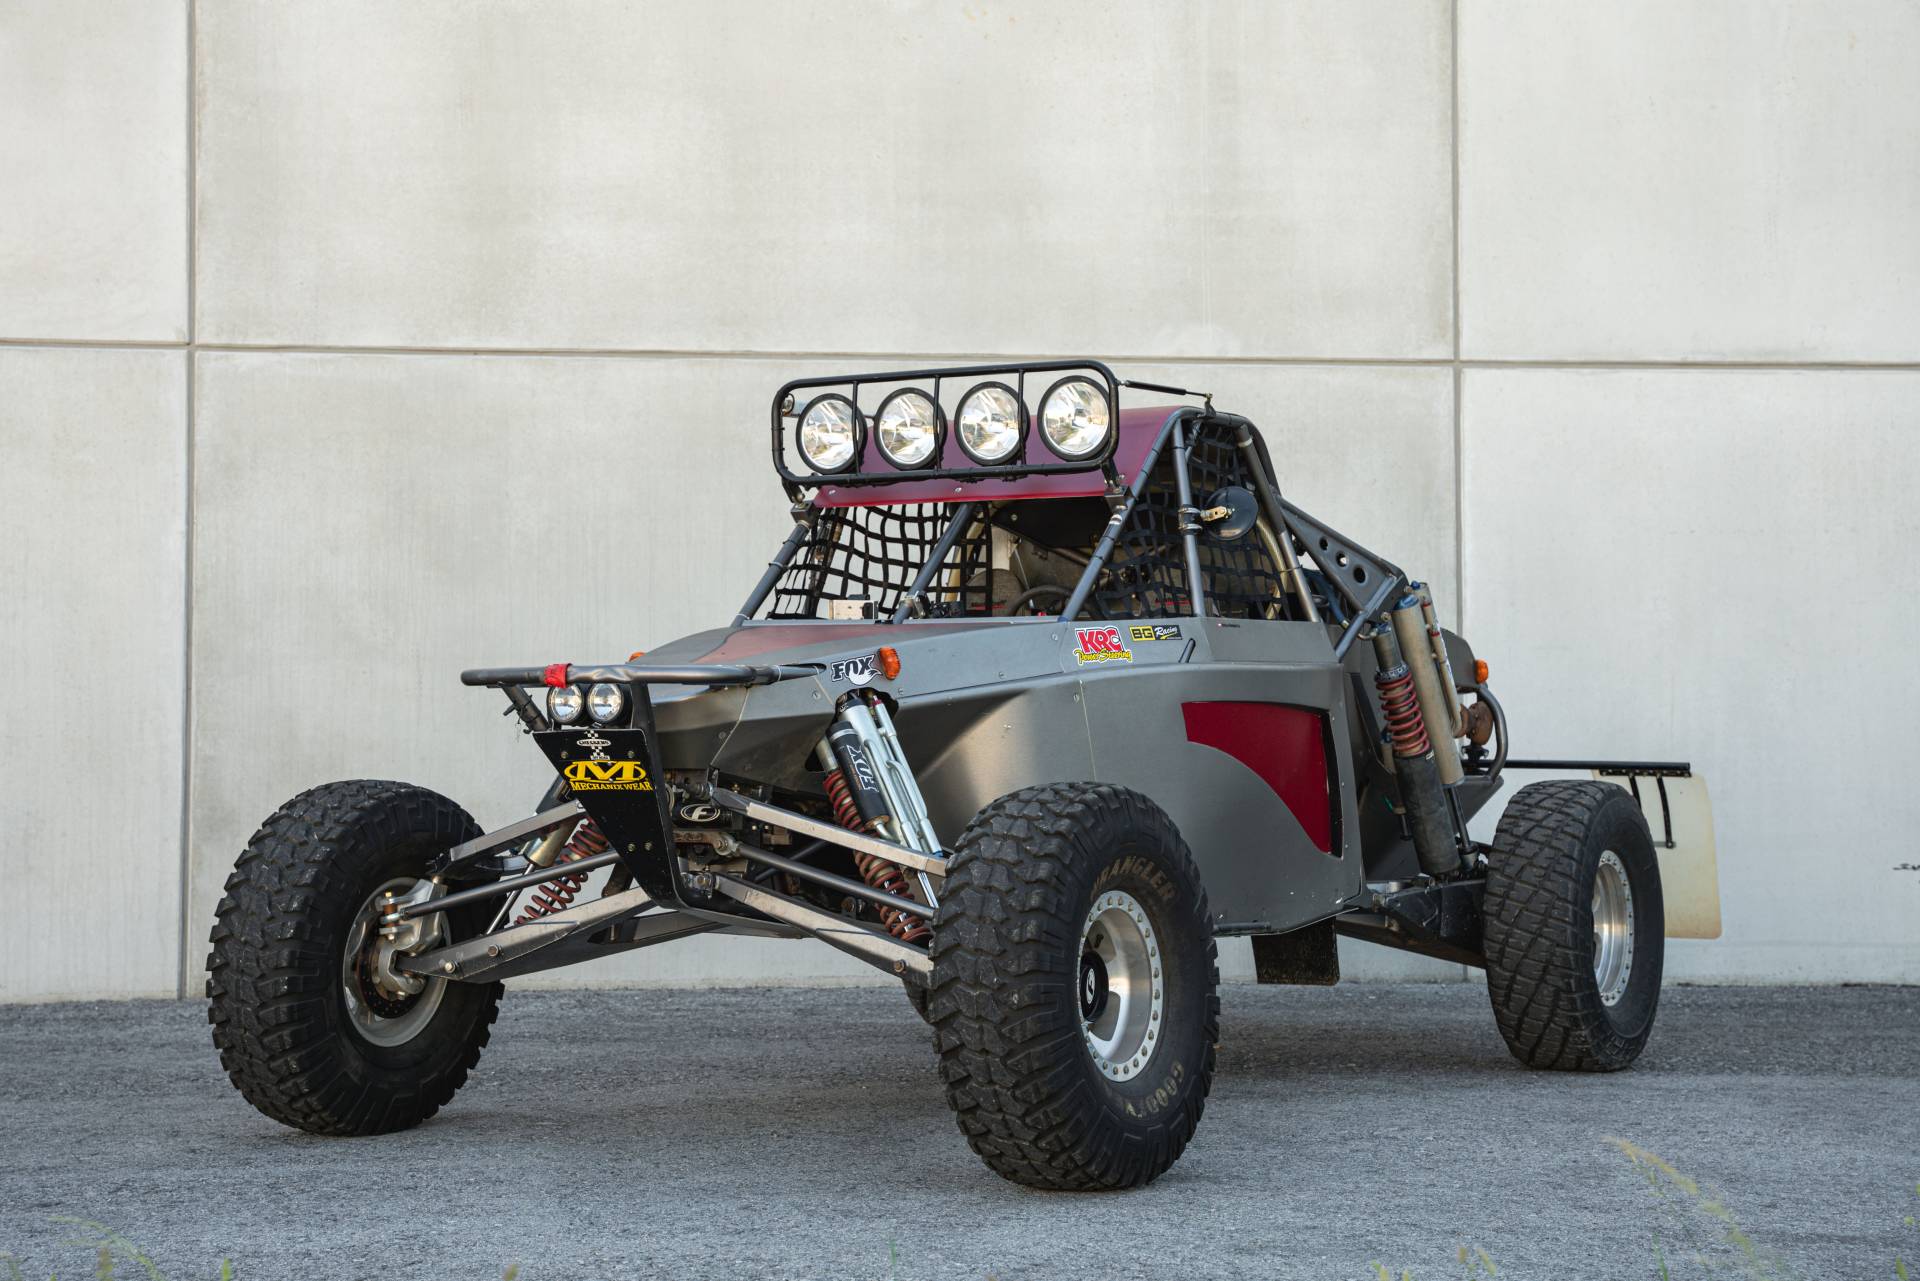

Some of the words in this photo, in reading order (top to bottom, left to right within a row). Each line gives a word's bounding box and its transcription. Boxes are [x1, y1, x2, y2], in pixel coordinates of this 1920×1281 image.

[1076, 627, 1123, 654] KRC
[1154, 626, 1178, 637] Racing
[831, 654, 876, 682] FOX
[1073, 648, 1100, 665] Power
[1099, 648, 1133, 662] Steering
[846, 744, 880, 793] FOX
[570, 781, 624, 791] MECHANIX
[623, 781, 654, 791] WEAR
[1090, 855, 1176, 900] WRANGLER
